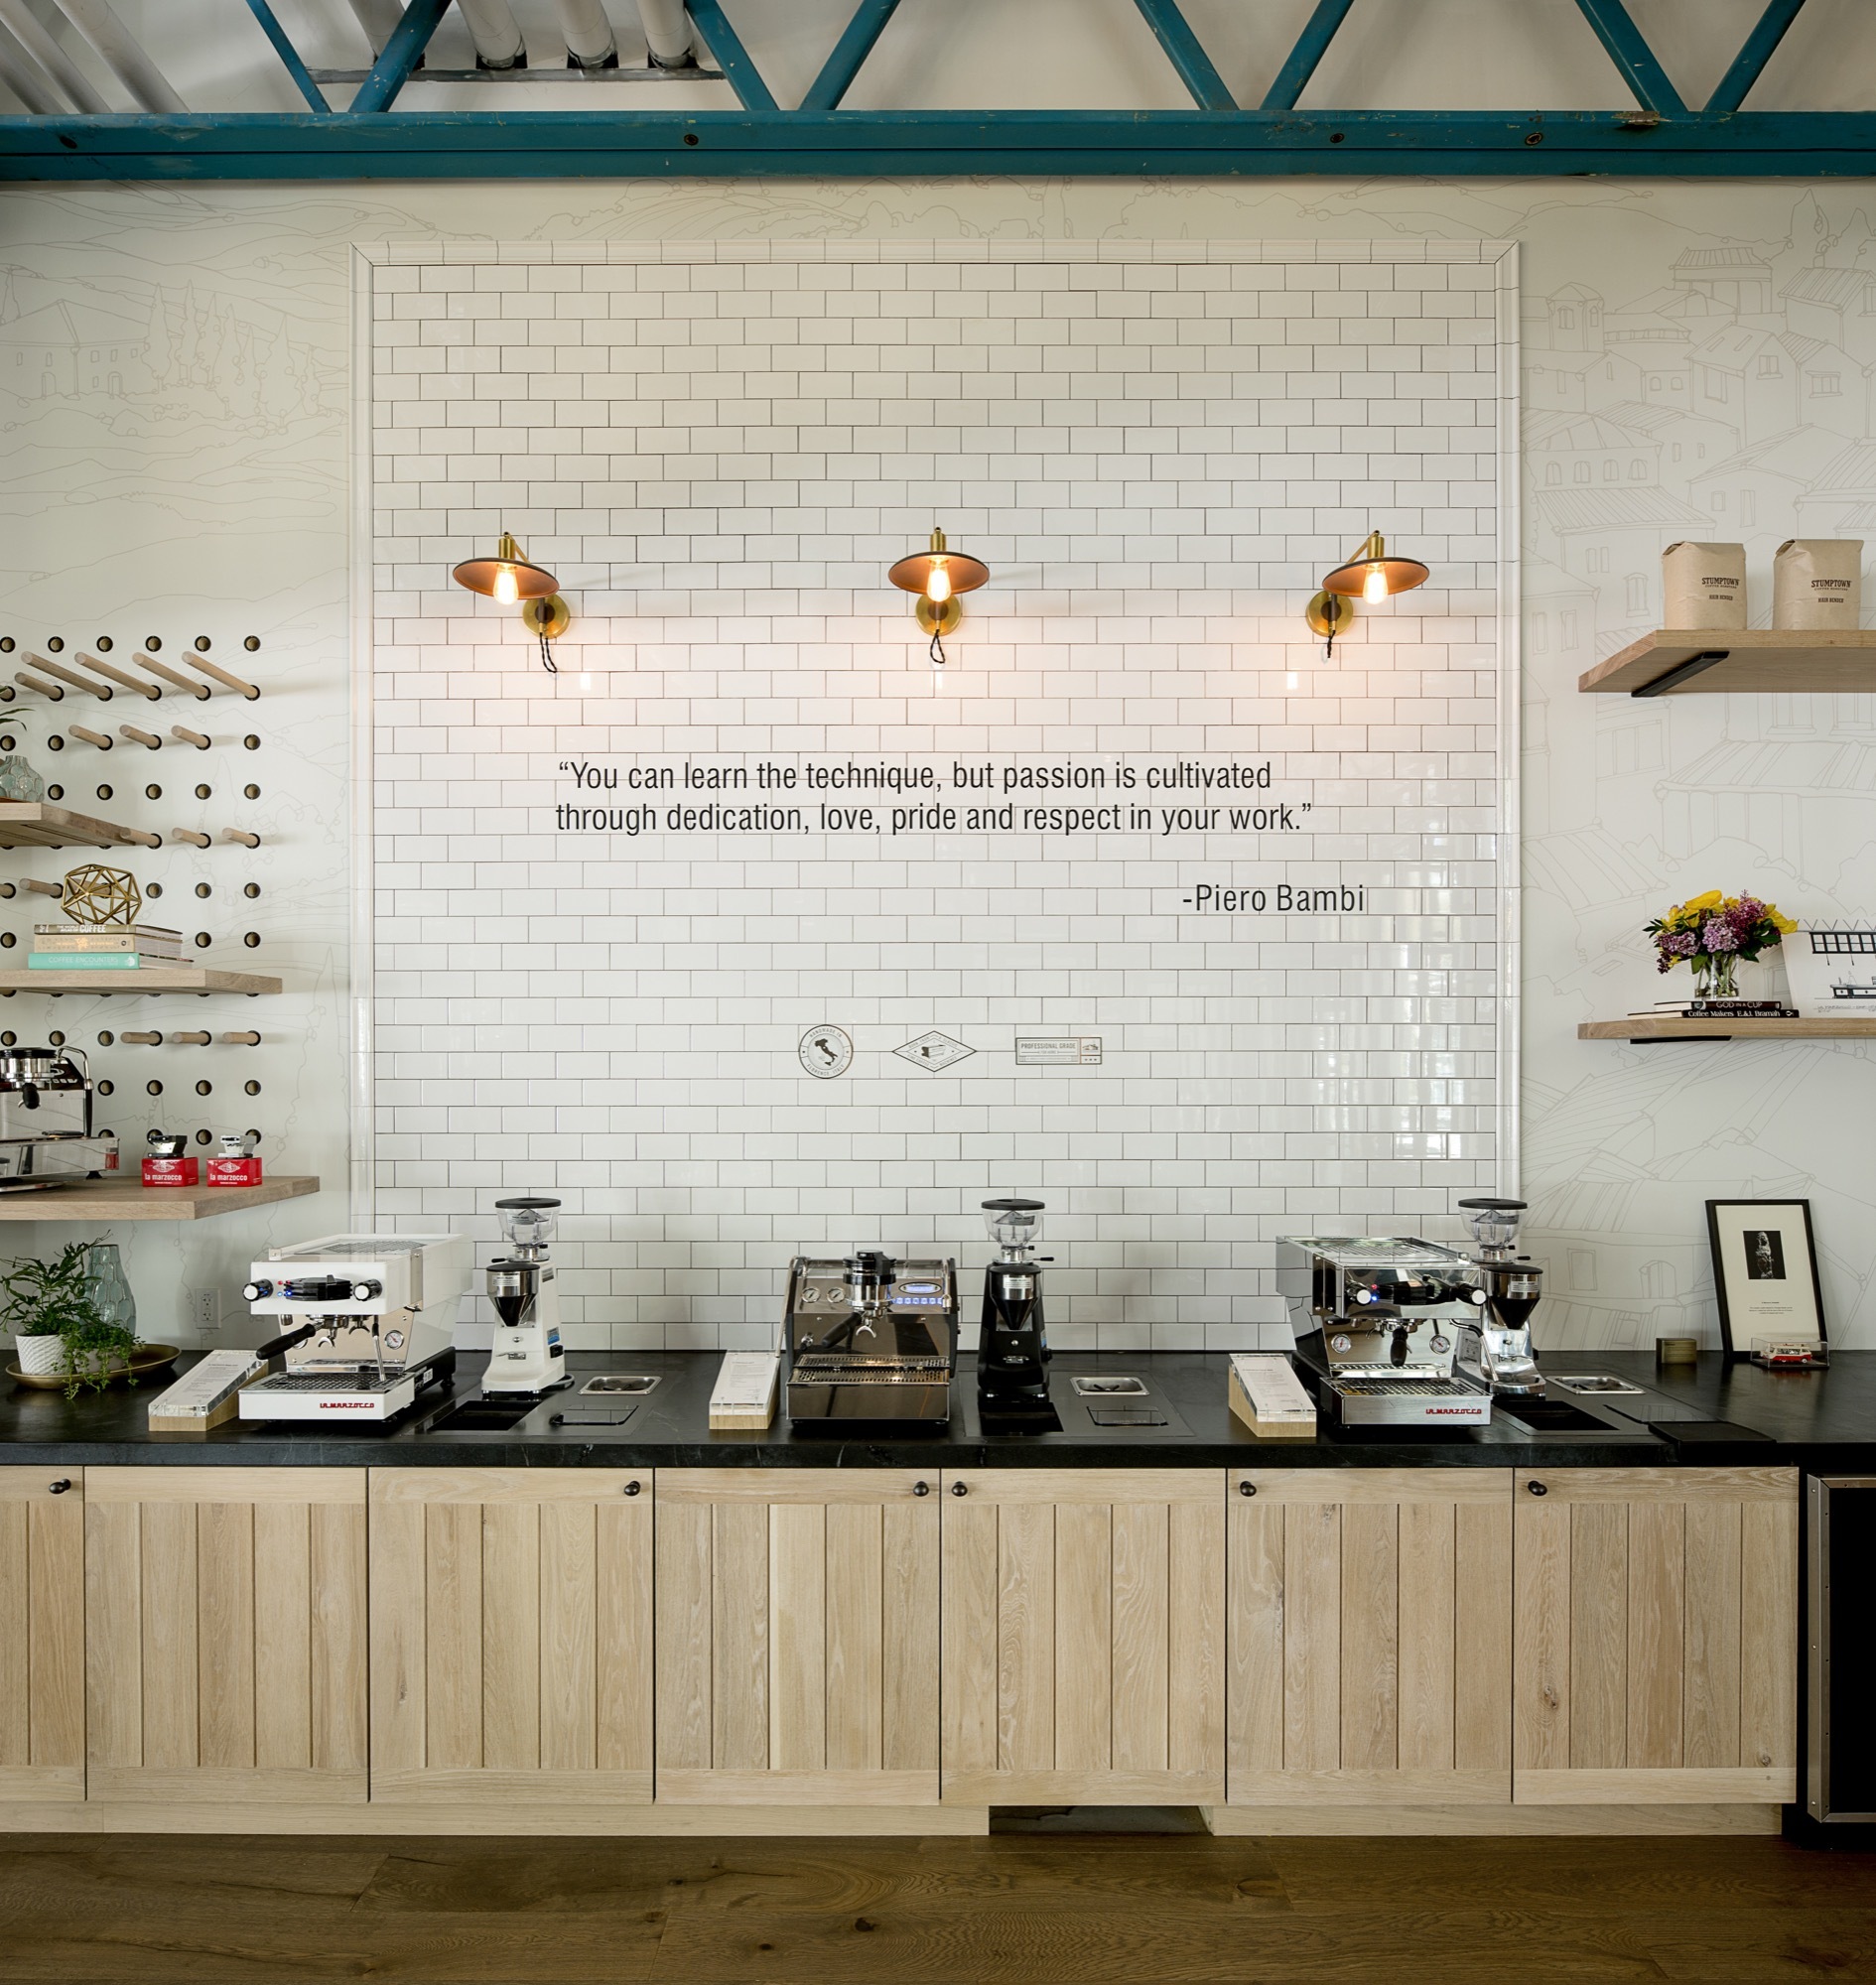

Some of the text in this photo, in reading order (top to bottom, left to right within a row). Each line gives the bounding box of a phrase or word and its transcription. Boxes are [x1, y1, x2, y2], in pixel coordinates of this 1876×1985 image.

[1701, 577, 1739, 586] STUMPTOWN
[1810, 579, 1851, 588] STUMPTOWN
[629, 767, 674, 789] can
[685, 761, 747, 789] learn
[757, 761, 796, 789] the
[805, 761, 941, 796] technique,
[953, 761, 995, 789] but
[1005, 761, 1105, 796] passion
[1117, 761, 1137, 789] is
[1147, 761, 1271, 789] cultivated
[556, 803, 656, 836] through
[667, 803, 809, 835] dedication,
[821, 803, 880, 835] love,
[892, 803, 956, 836] pride
[968, 803, 1012, 830] and
[1024, 804, 1122, 837] respect
[1131, 803, 1151, 830] in
[1162, 808, 1221, 837] your
[1182, 883, 1366, 912] -Piero Bambi
[79, 924, 107, 933] COFFEE
[809, 1027, 836, 1038] HANDMADE
